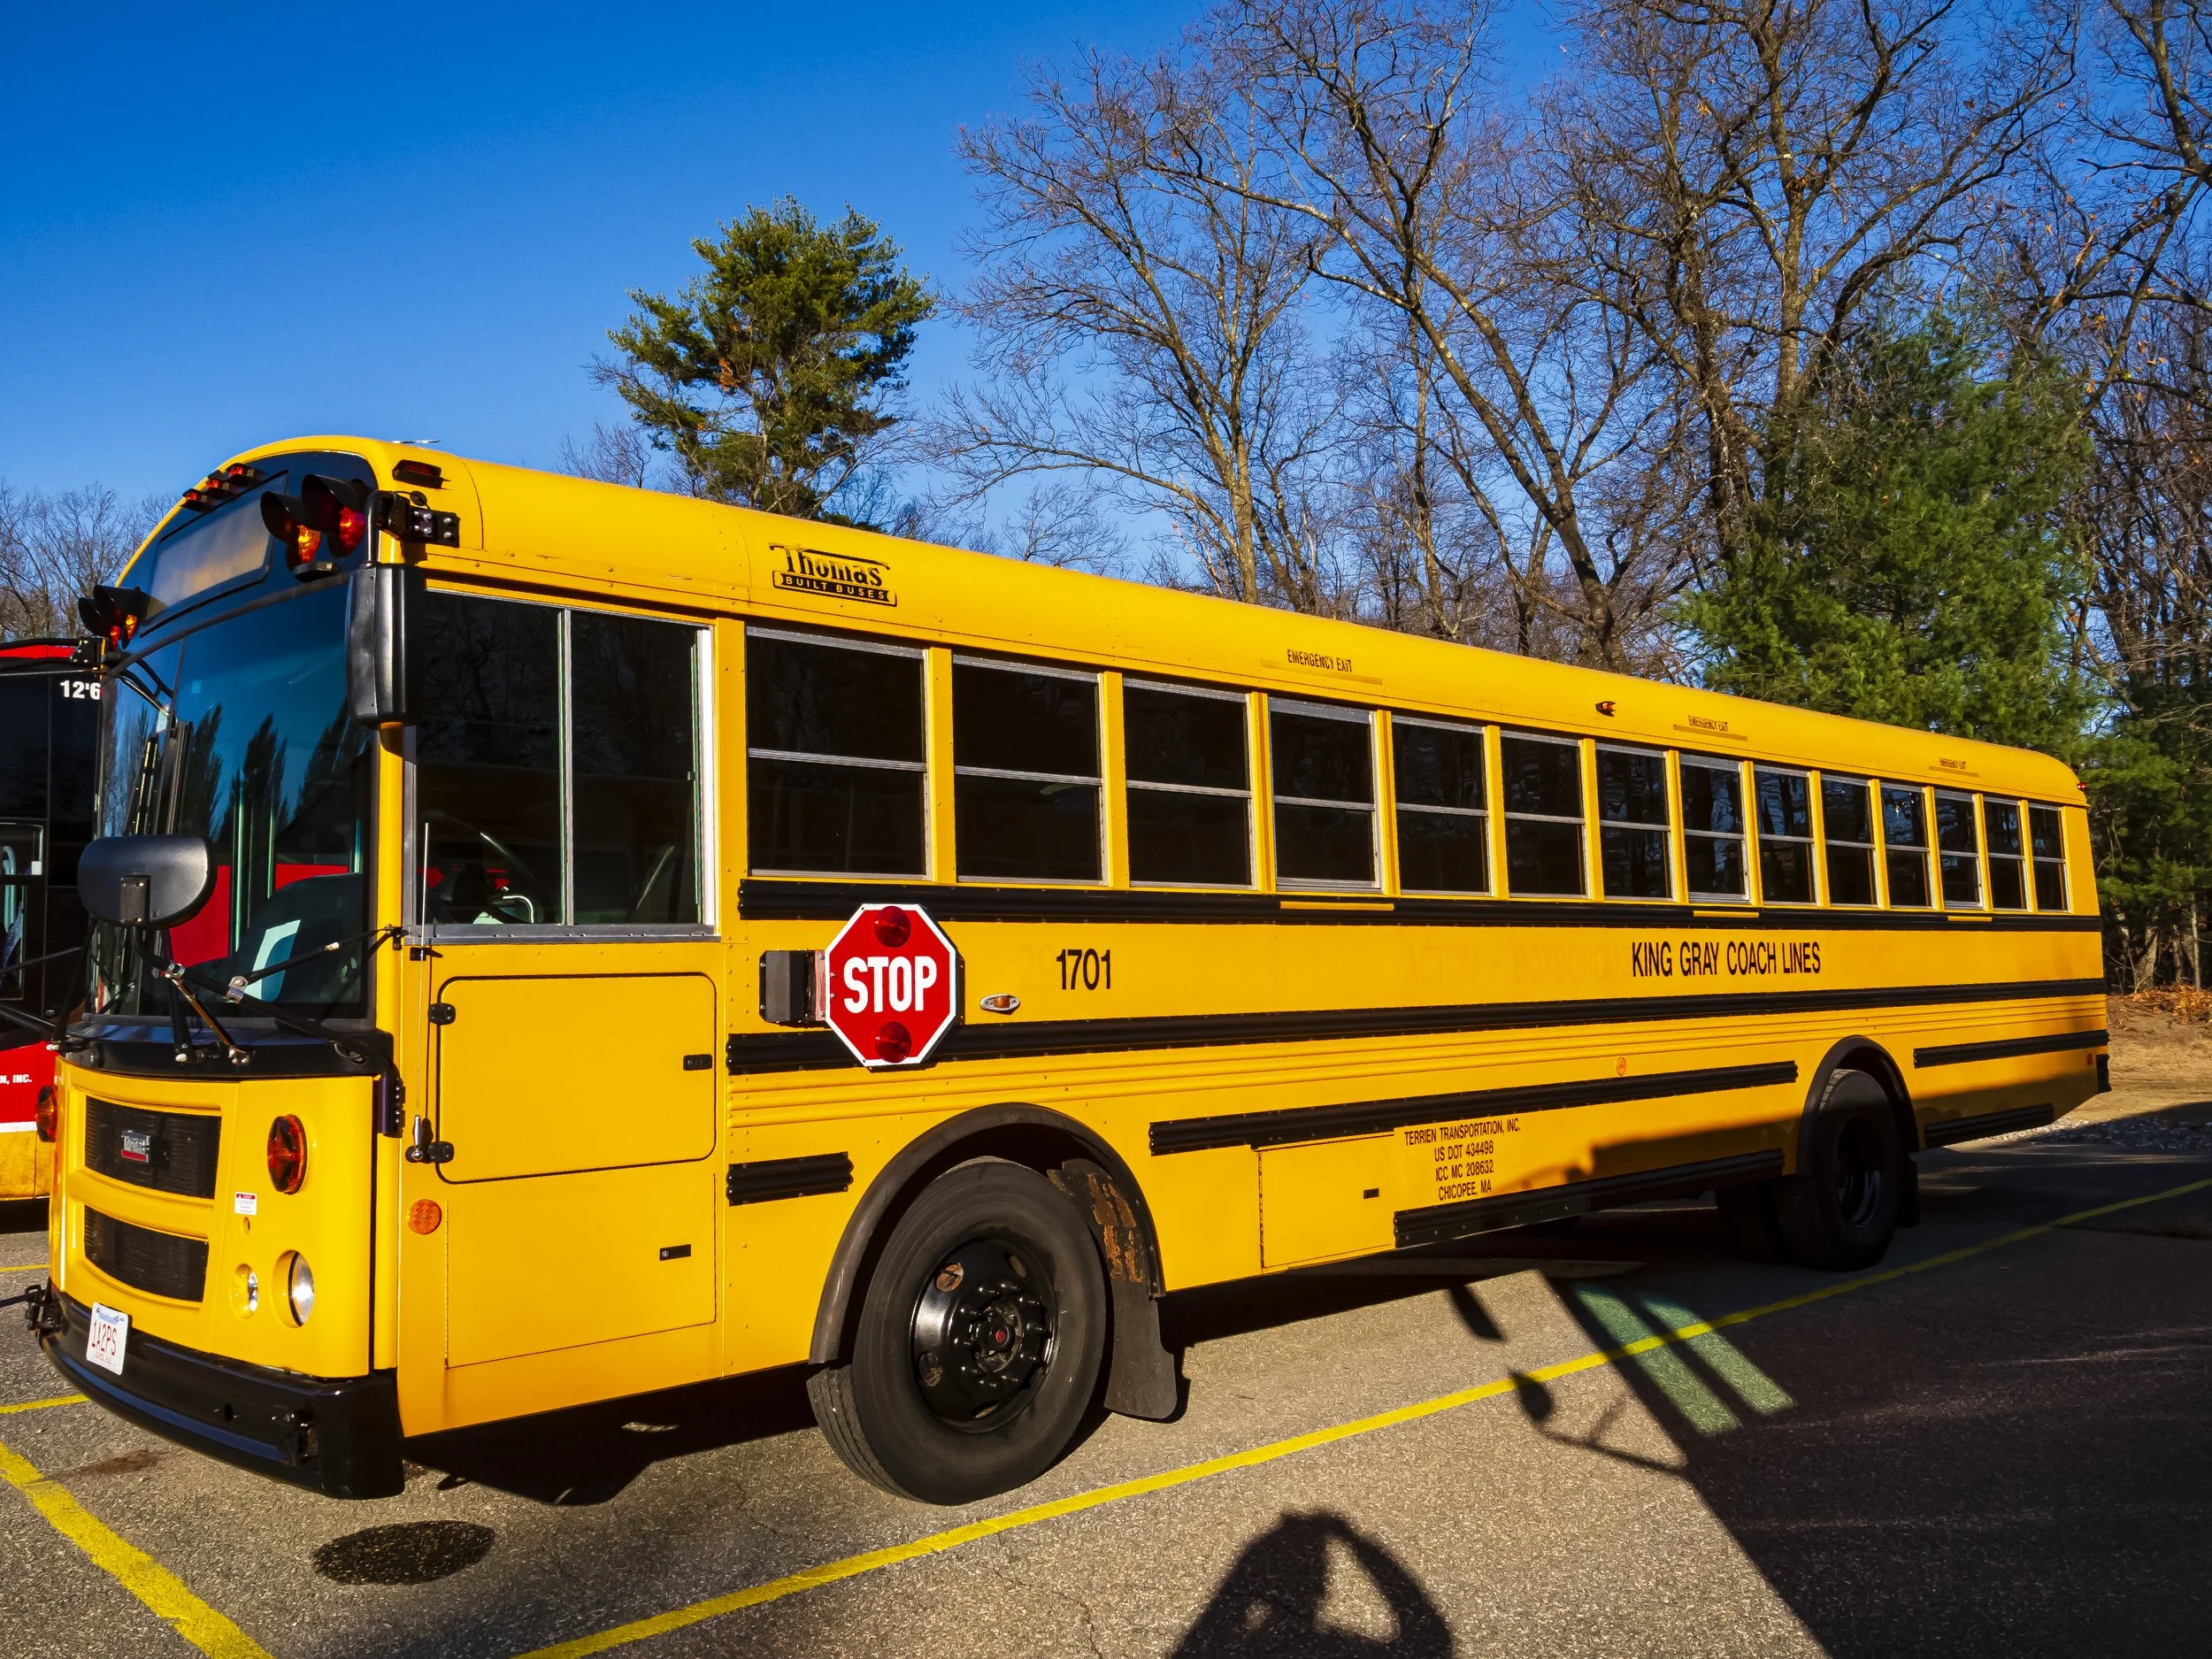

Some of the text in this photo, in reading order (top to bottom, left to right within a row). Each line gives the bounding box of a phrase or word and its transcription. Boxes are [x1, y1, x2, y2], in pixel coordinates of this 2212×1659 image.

[768, 541, 891, 588] Thomas
[786, 576, 885, 600] BUILT BUSES
[1286, 649, 1353, 672] EMERGENCY EXIT
[1056, 948, 1111, 991] 1701
[1632, 941, 1672, 977] KING
[1679, 941, 1720, 976] GRAY
[1726, 941, 1777, 976] COACH
[1781, 941, 1821, 974] LINES
[843, 956, 938, 1014] STOP
[12, 1073, 33, 1084] INC.
[1404, 1118, 1521, 1146] TERRIEN TRANSPORTATION, INC.
[1434, 1140, 1494, 1162] US DOT 434498
[1435, 1159, 1494, 1182] ICC MC 208632
[1438, 1179, 1492, 1202] CHICOPEE, MA
